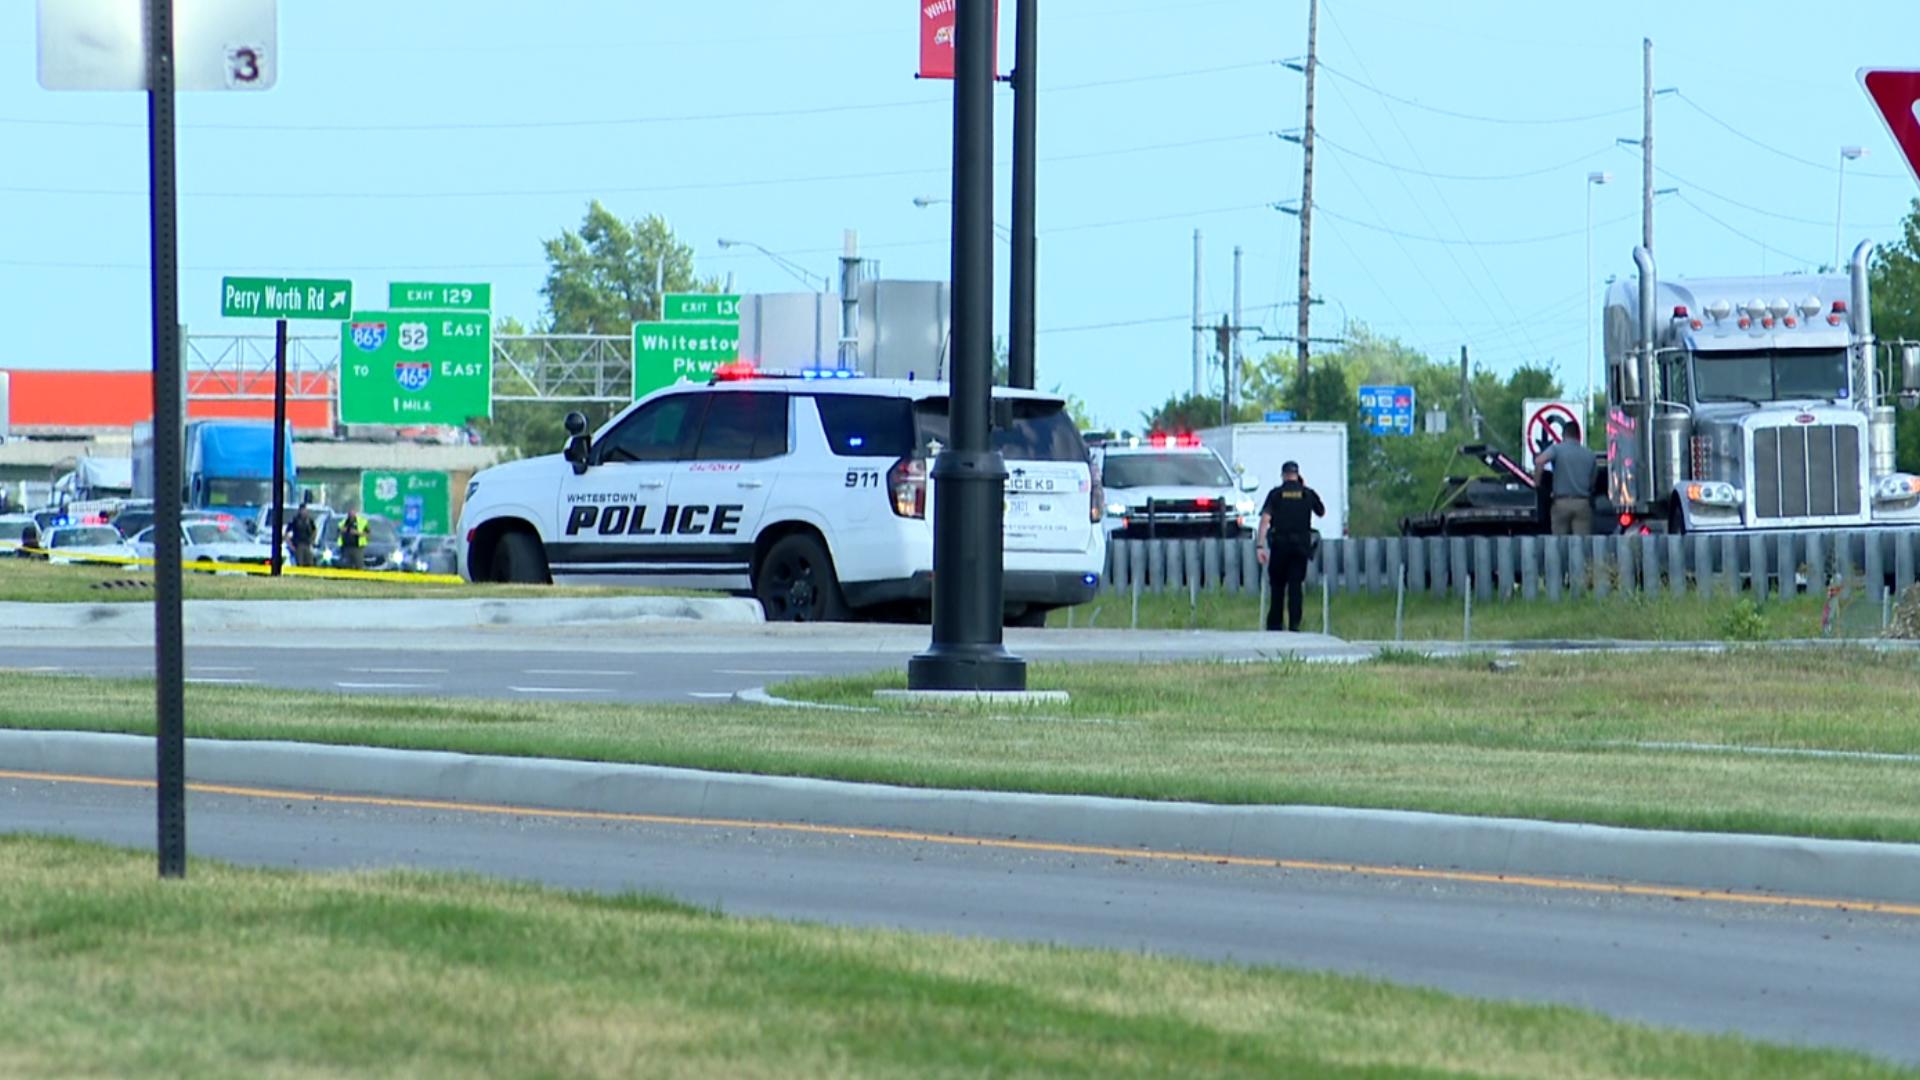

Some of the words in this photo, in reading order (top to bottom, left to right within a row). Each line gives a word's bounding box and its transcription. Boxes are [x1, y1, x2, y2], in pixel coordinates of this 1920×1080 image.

[234, 48, 259, 81] 3
[226, 285, 260, 314] Perry
[265, 286, 301, 311] Worth
[308, 287, 324, 311] Rd
[407, 292, 433, 302] EXIT
[442, 290, 472, 304] 129
[681, 302, 708, 313] EXIT
[354, 328, 385, 347] 865
[402, 330, 425, 346] 52
[441, 321, 483, 337] EAST
[353, 365, 369, 376] TO
[398, 368, 428, 387] 465
[441, 361, 483, 376] EAST
[393, 397, 400, 412] 1
[402, 399, 432, 411] MILE
[845, 472, 878, 488] 911
[1004, 479, 1031, 490] ICE
[566, 493, 638, 503] WHITESTOWN
[565, 504, 744, 535] POLICE
